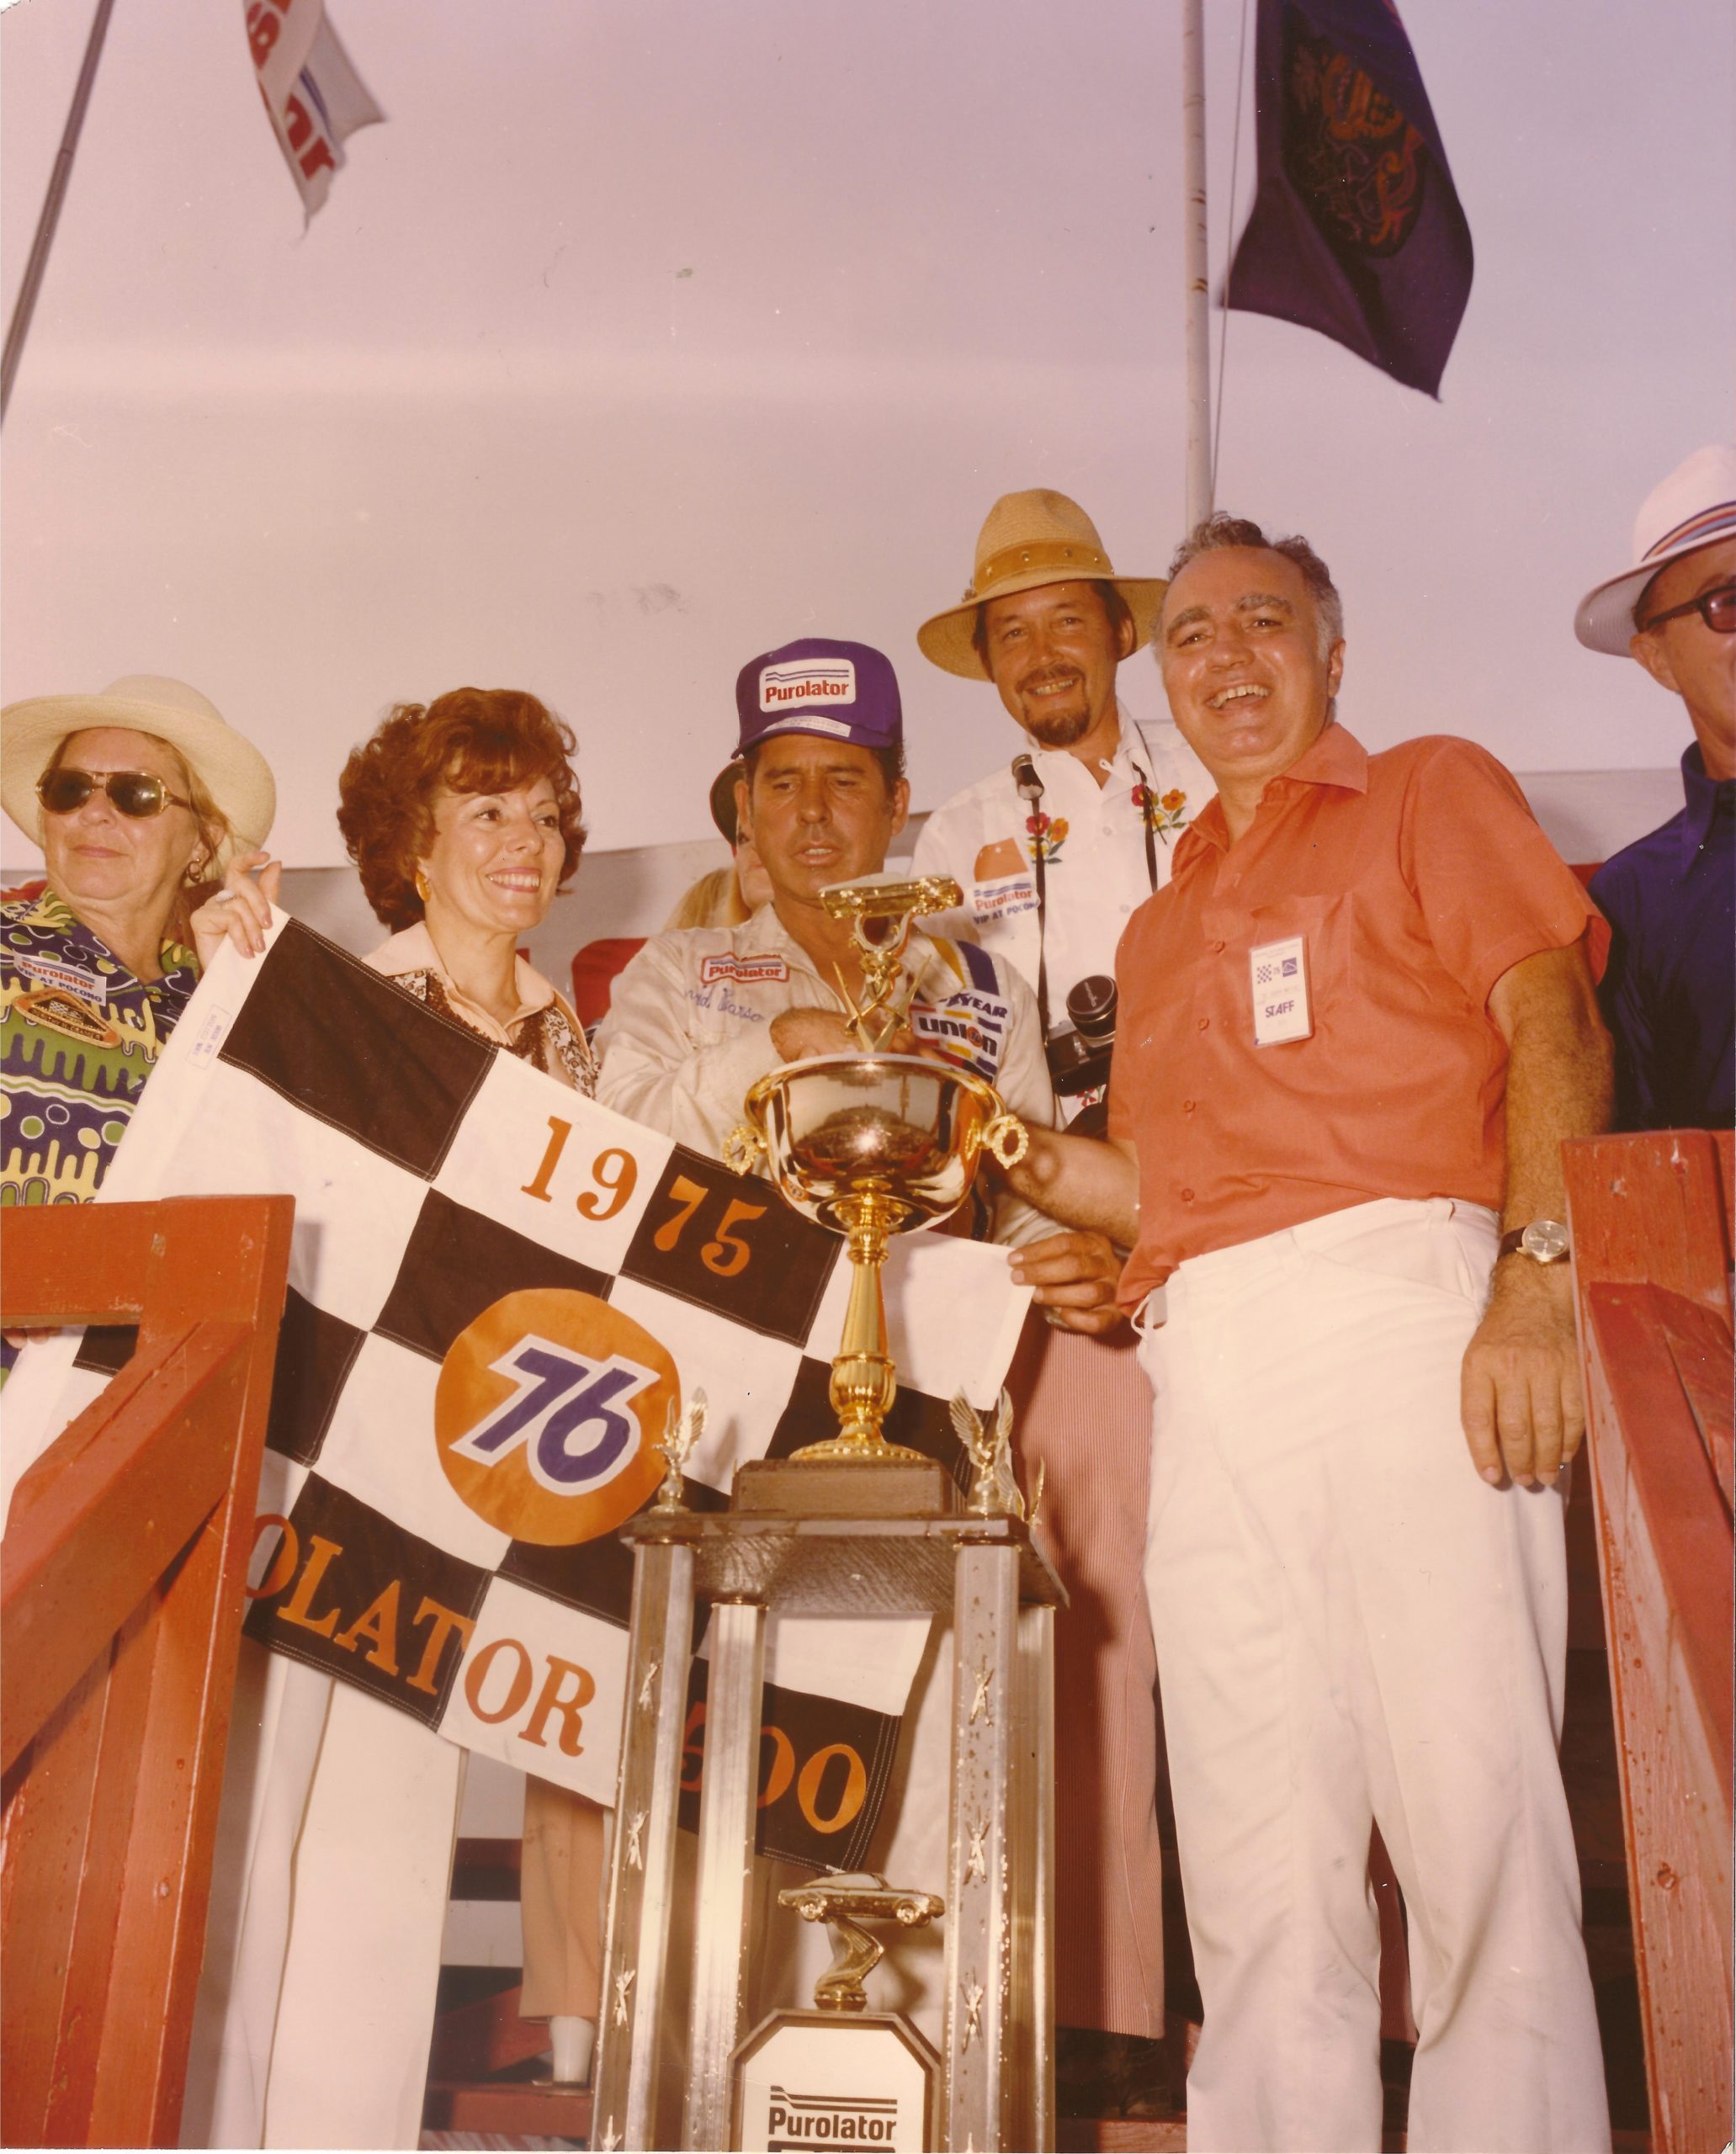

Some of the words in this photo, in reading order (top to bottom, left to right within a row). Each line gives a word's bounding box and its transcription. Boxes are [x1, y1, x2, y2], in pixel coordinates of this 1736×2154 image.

[765, 680, 850, 703] Purolator
[974, 889, 1033, 911] Purolator
[973, 914, 989, 925] VIP
[992, 910, 1004, 920] AT
[21, 961, 95, 990] Purolator
[709, 965, 782, 978] Purolator
[58, 982, 103, 1003] POCONO
[1266, 1000, 1295, 1018] STAFF
[449, 1334, 661, 1497] 76
[768, 2106, 897, 2141] Purolator
